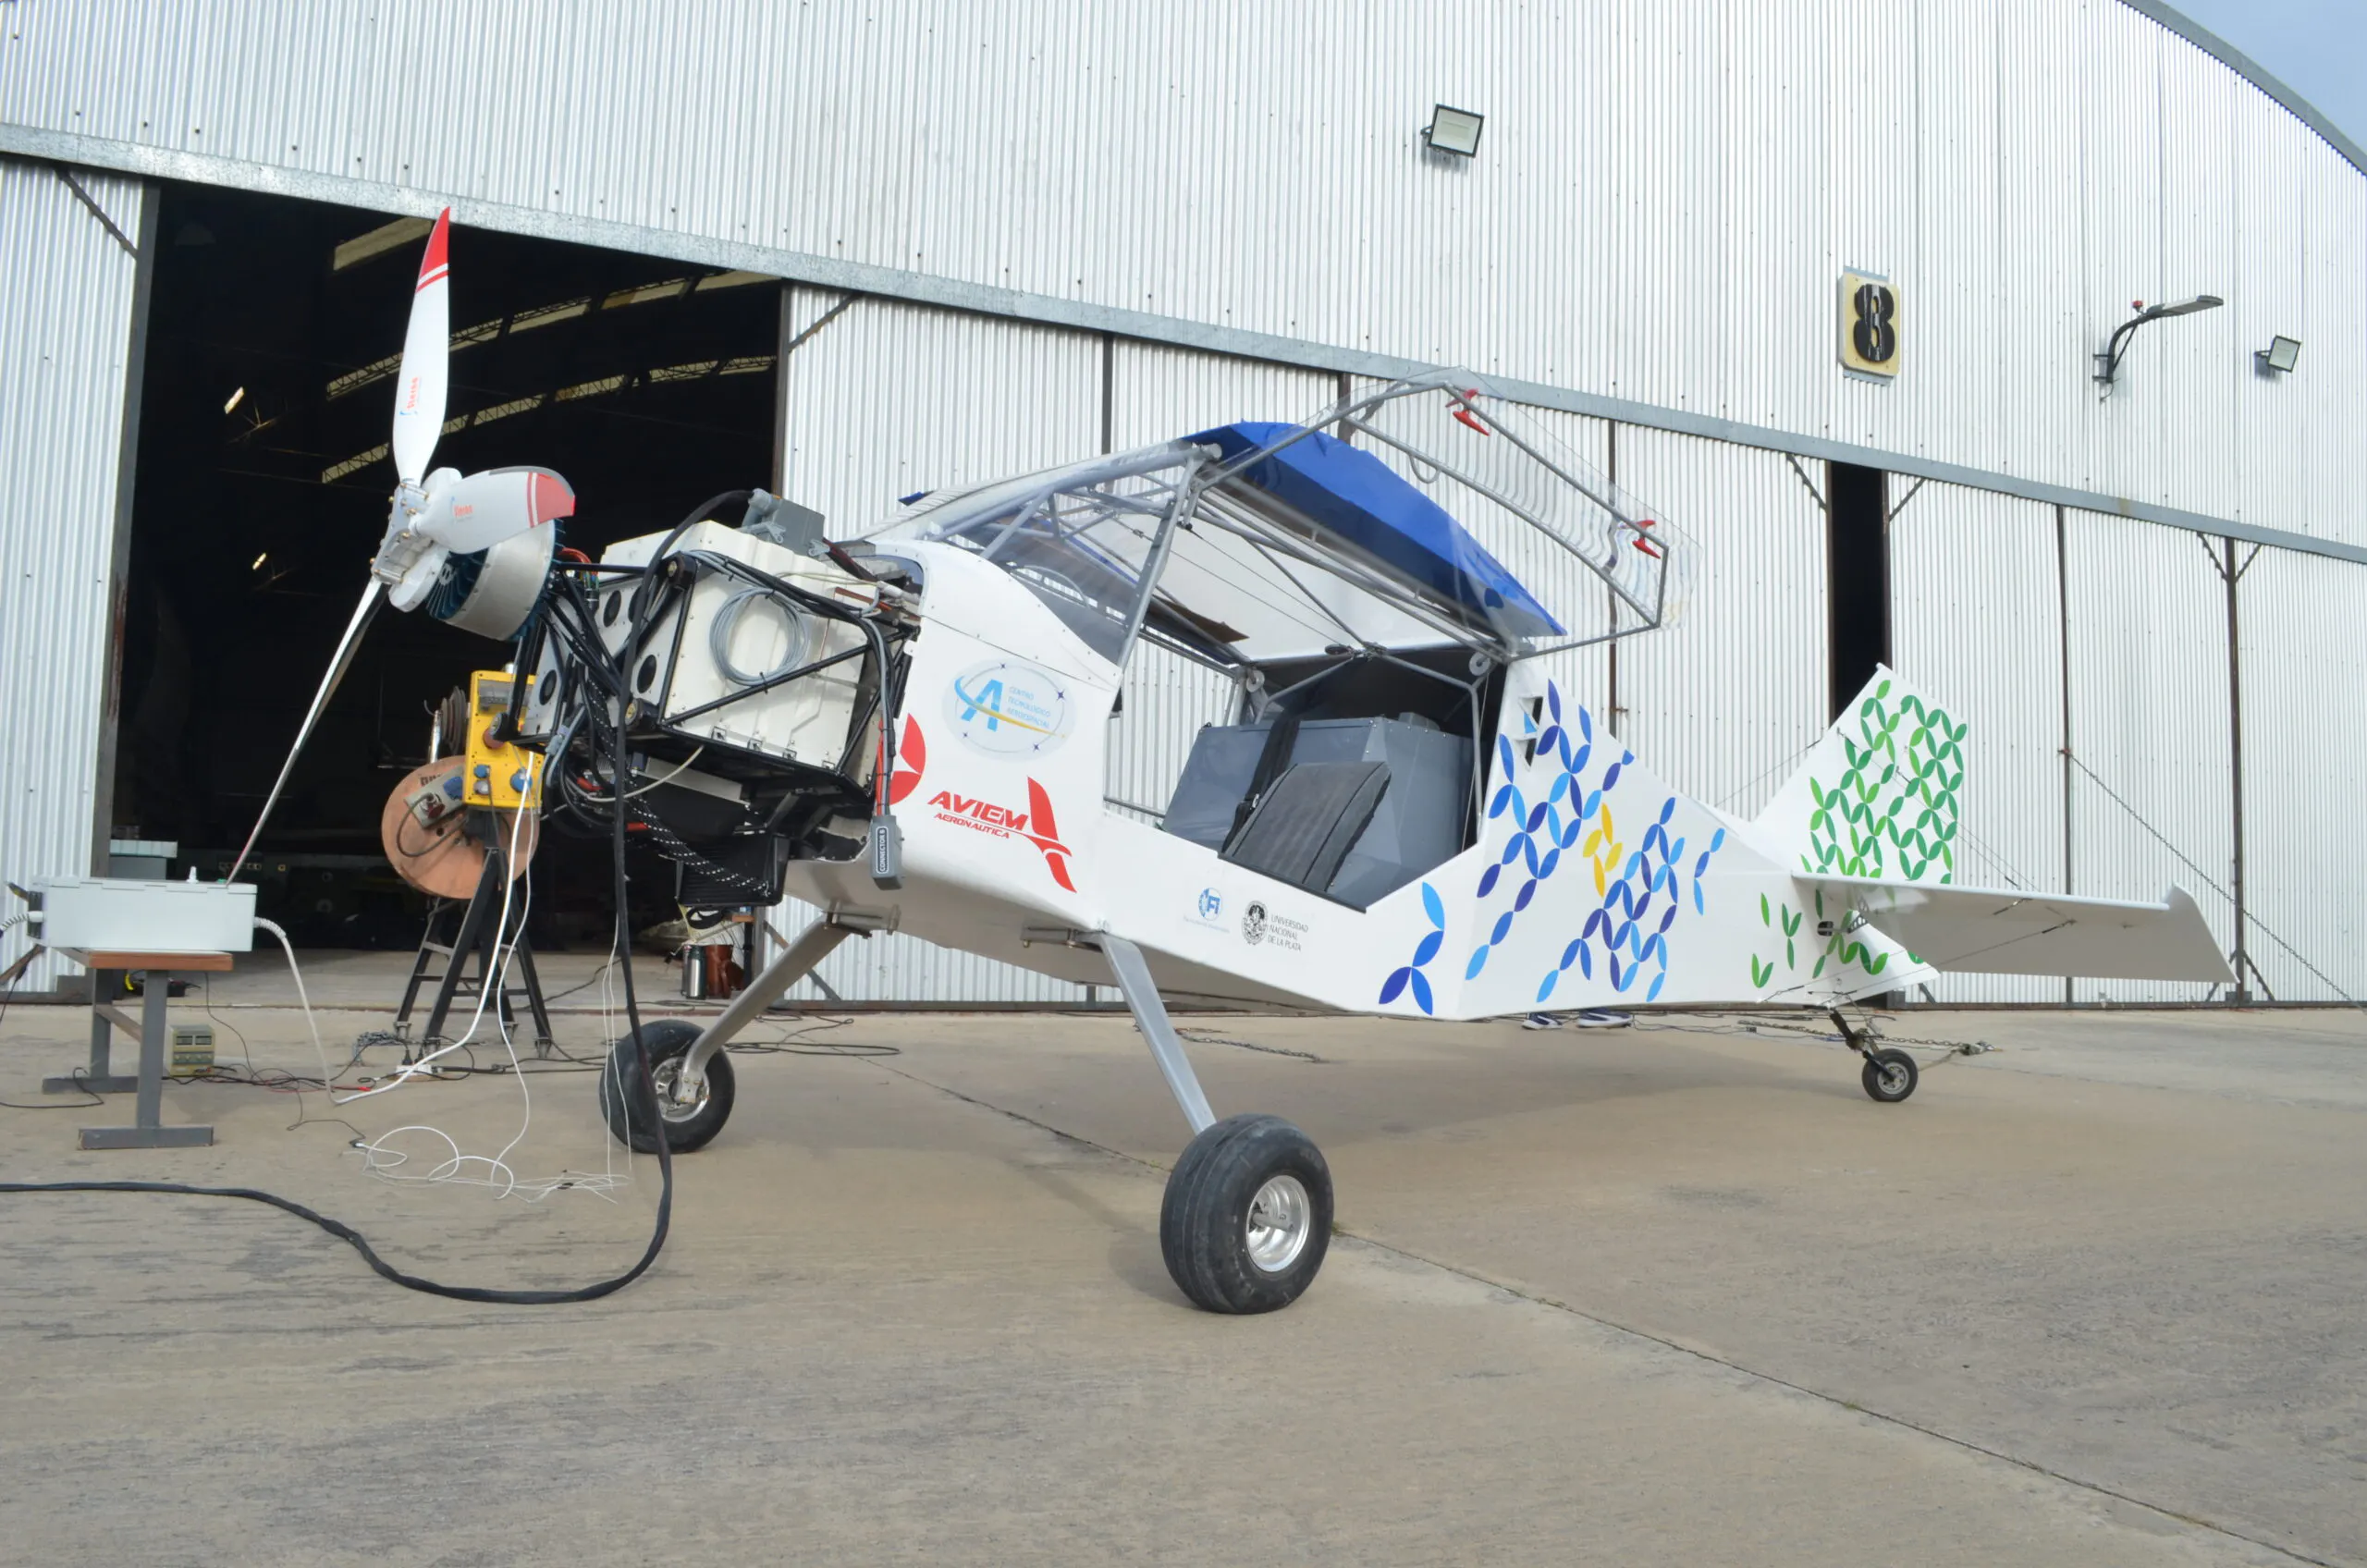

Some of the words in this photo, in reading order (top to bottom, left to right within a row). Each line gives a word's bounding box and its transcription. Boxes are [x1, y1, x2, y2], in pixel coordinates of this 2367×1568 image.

[1853, 283, 1895, 363] 8
[1009, 686, 1034, 701] CENTRO
[927, 790, 1029, 831] AVIEM
[934, 813, 1011, 839] AERONAUTICA
[1269, 925, 1298, 940] NACIONAL
[1270, 914, 1308, 933] UNIVERSIDAD
[1268, 935, 1276, 944] DE
[1276, 937, 1283, 946] LA
[1284, 939, 1302, 951] PLATA
